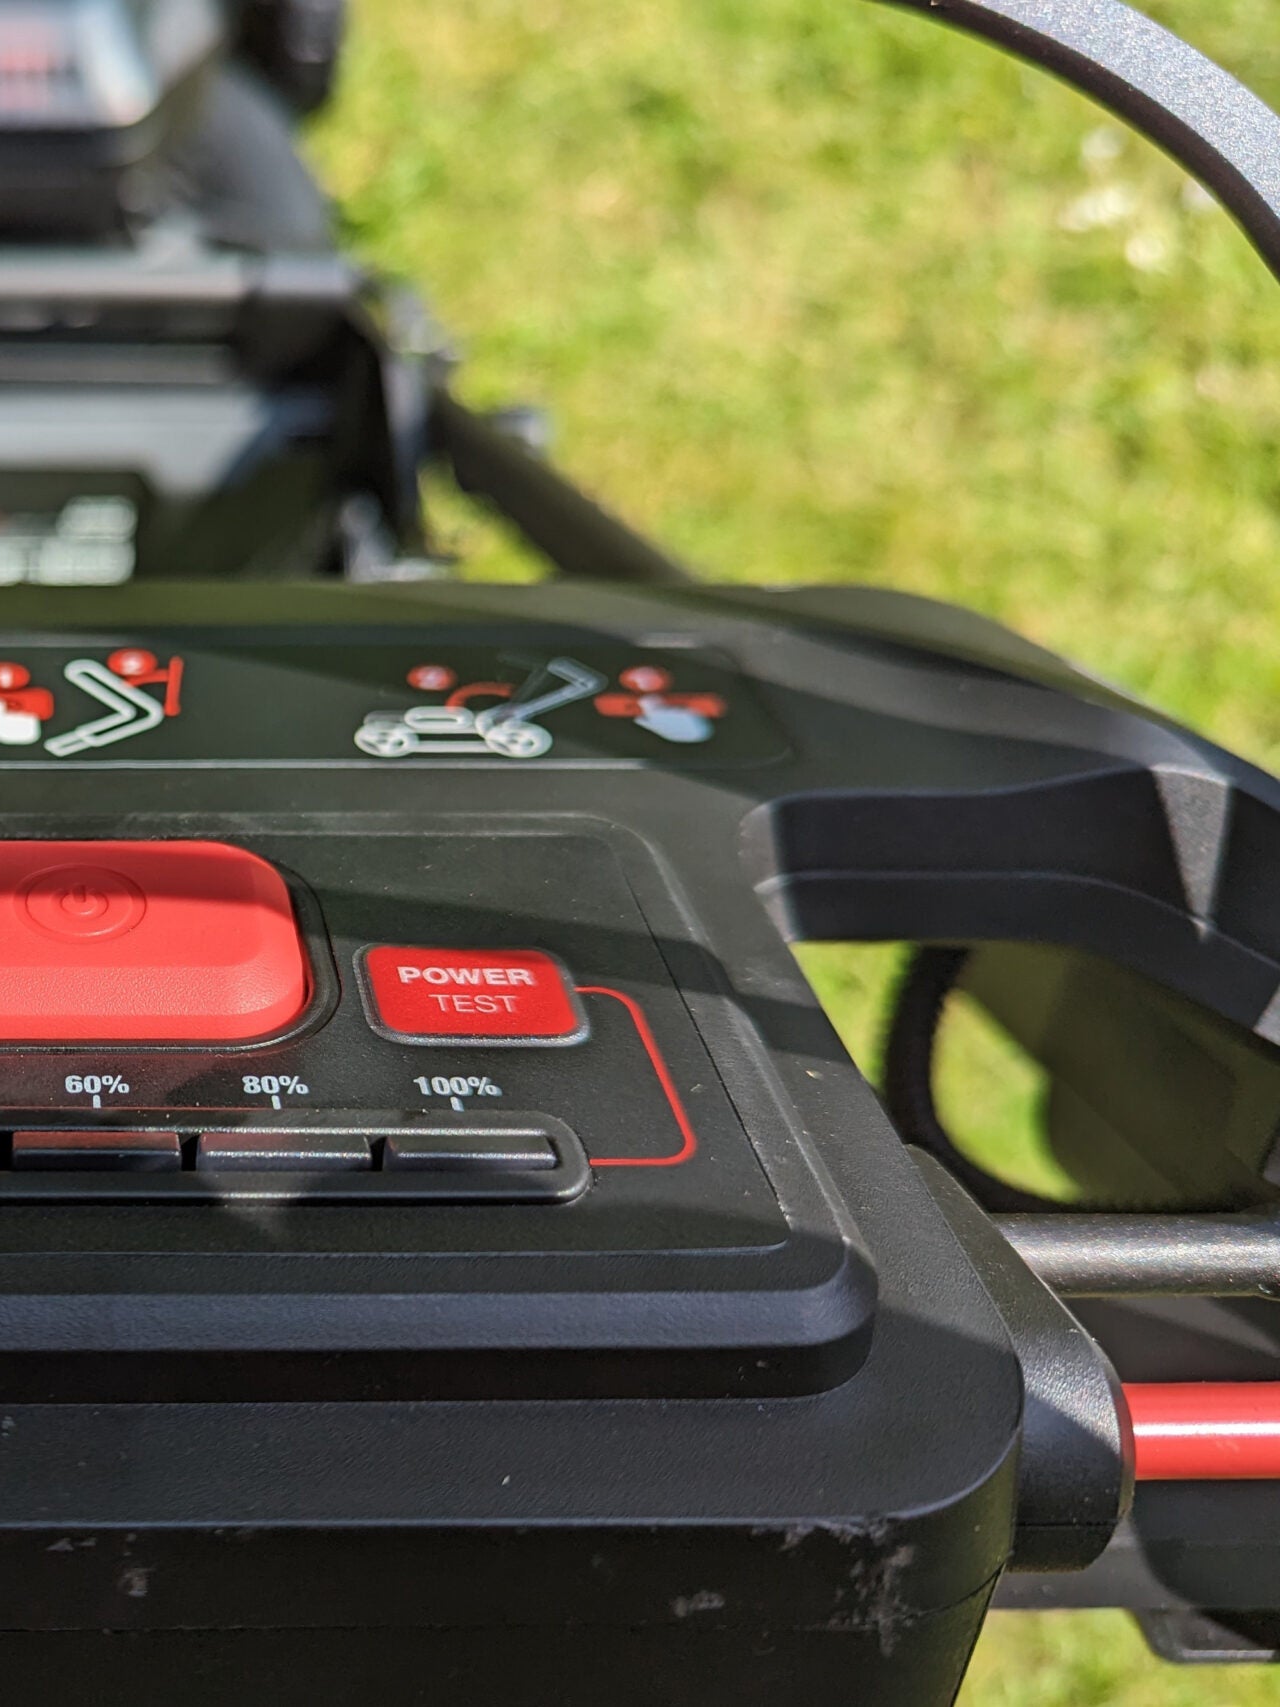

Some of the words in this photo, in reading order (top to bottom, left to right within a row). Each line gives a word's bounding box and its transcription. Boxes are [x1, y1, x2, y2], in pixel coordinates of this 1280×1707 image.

[397, 966, 535, 986] POWER
[428, 993, 517, 1014] TEST
[65, 1075, 130, 1095] 60%
[242, 1075, 309, 1095] 80%
[413, 1075, 503, 1097] 100%
